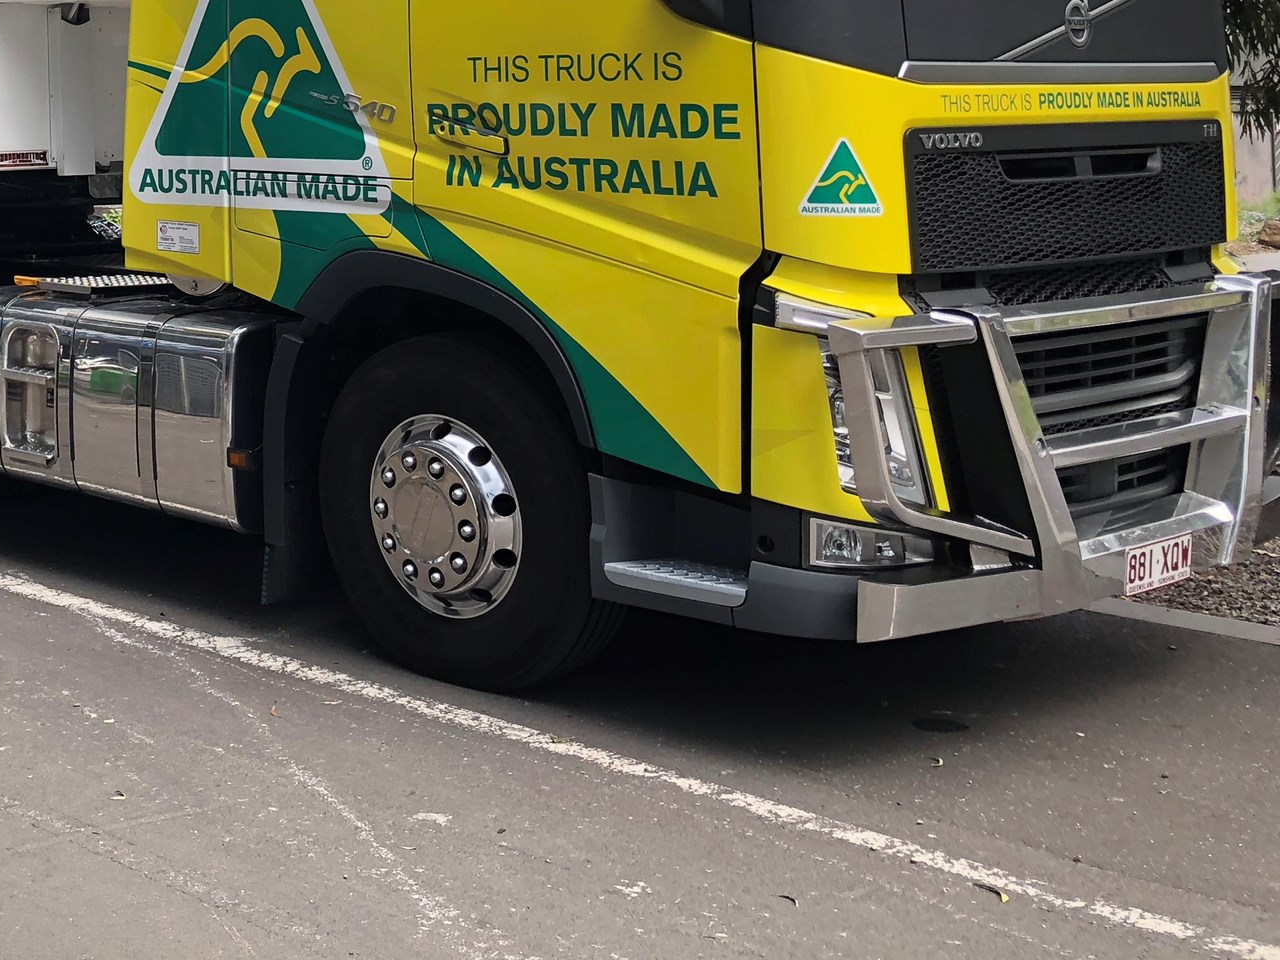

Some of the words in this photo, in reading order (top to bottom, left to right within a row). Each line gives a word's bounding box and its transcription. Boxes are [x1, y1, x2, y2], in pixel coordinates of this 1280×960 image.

[467, 54, 530, 83] THIS
[538, 52, 643, 83] TRUCK
[653, 51, 683, 82] IS
[343, 92, 396, 124] 540
[940, 93, 971, 113] THIS
[974, 93, 1017, 112] TRUCK
[1020, 92, 1033, 111] IS
[1039, 92, 1093, 110] PROUDLY
[1097, 91, 1130, 109] MADE
[1132, 91, 1144, 108] IN
[1146, 91, 1201, 108] AUSTRALIA
[427, 102, 597, 137] PROUDLY
[611, 103, 741, 140] MADE
[920, 132, 984, 150] VOLVO
[138, 168, 289, 198] AUSTRALIAN
[296, 174, 379, 203] MADE
[445, 154, 483, 187] IN
[491, 155, 719, 198] AUSTRALIA
[801, 206, 856, 214] AUSTRALIAN
[858, 206, 881, 214] MADE
